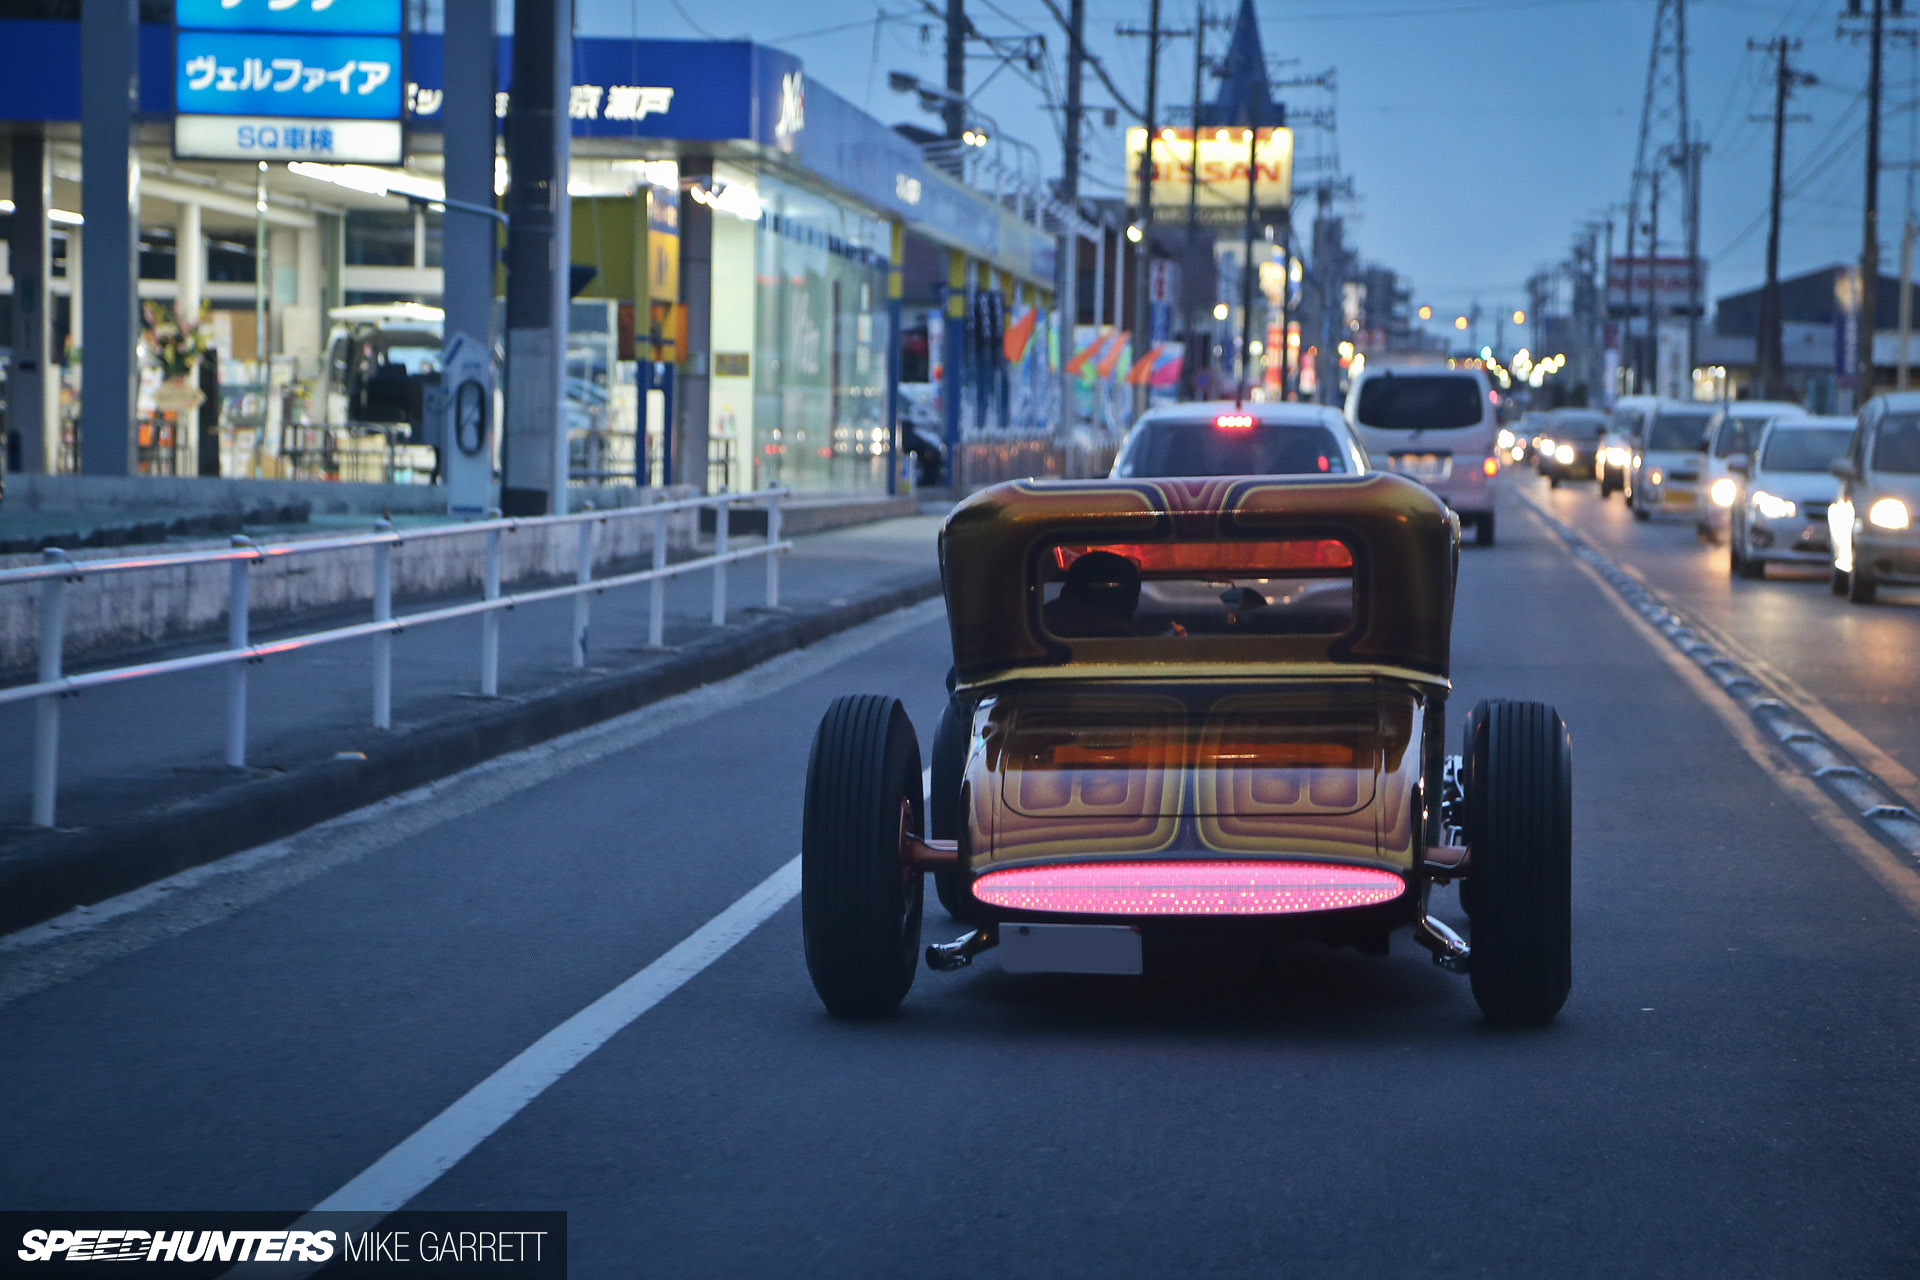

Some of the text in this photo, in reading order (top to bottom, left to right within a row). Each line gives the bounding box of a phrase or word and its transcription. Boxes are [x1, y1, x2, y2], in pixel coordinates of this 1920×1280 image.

[185, 54, 391, 96] ヴェルファイア
[236, 124, 334, 153] SQ車検
